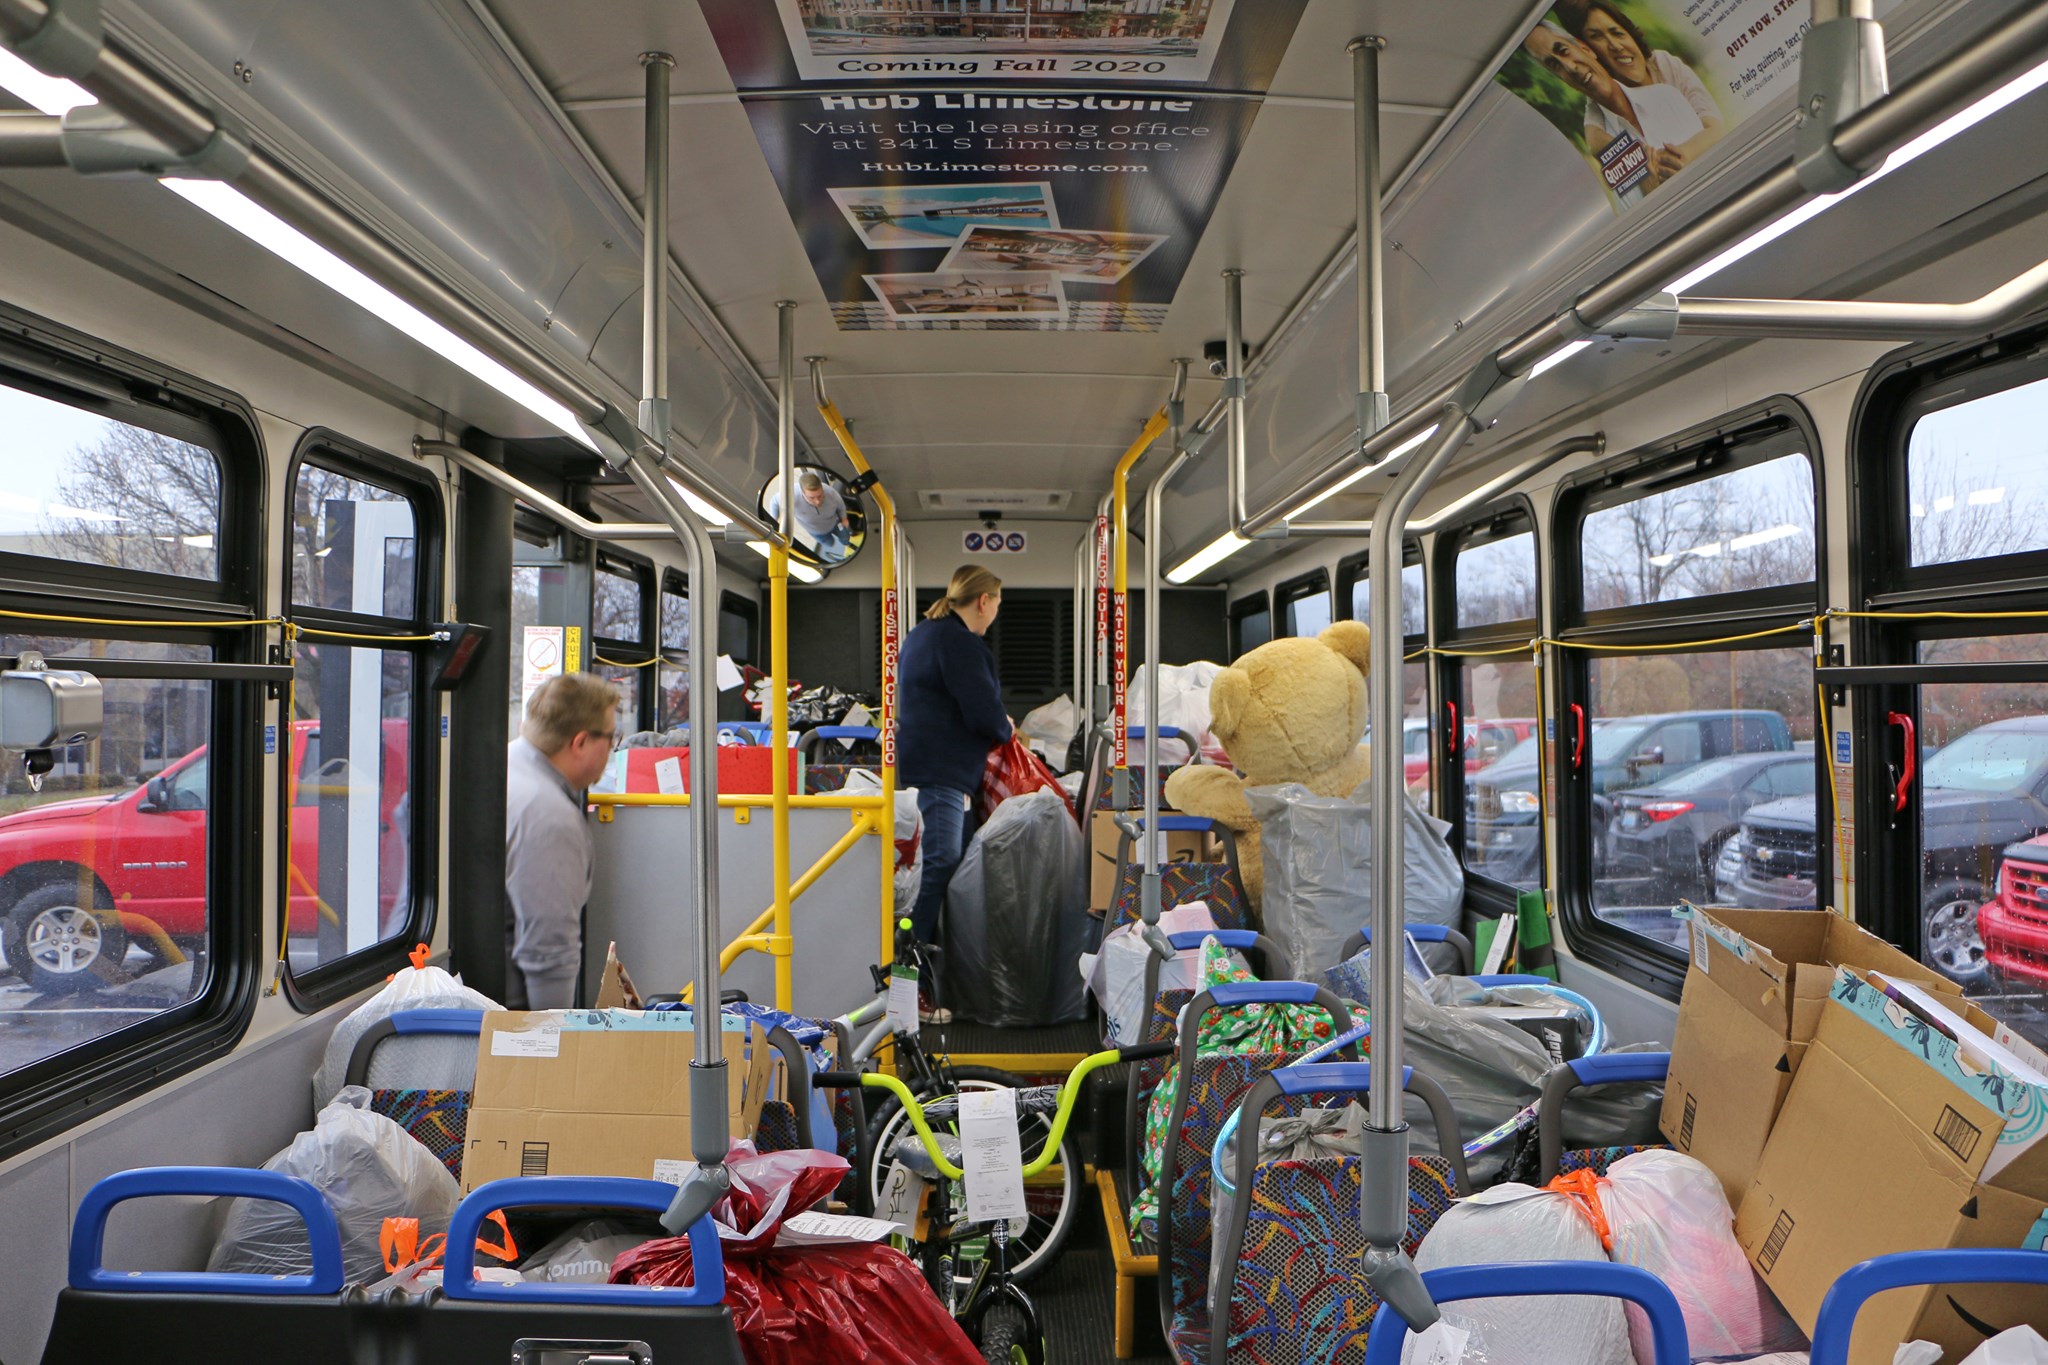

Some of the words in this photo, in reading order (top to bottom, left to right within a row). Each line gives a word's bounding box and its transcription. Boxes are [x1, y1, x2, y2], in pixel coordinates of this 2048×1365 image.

[1726, 33, 1749, 58] QUIT
[1748, 13, 1775, 38] NOW.
[1773, 0, 1798, 16] STA
[838, 59, 979, 74] Coming
[993, 59, 1057, 72] Fall
[1071, 60, 1166, 73] 2020
[1729, 79, 1742, 94] For
[1739, 68, 1757, 85] help
[1785, 32, 1801, 49] text
[820, 94, 920, 111] Hub
[934, 94, 1193, 112] Limestone
[800, 121, 884, 134] Visit
[895, 121, 954, 134] the
[968, 120, 1099, 138] leasing
[1110, 122, 1210, 136] office
[833, 139, 867, 150] at
[879, 138, 939, 150] 341
[953, 138, 971, 150] S
[985, 138, 1179, 151] Limestone.
[861, 162, 1149, 173] HubLimestone.com
[1600, 135, 1630, 164] KENTUCKY
[1098, 560, 1107, 588] CON
[886, 591, 896, 637] PISE
[1114, 594, 1125, 652] WATCH
[886, 642, 896, 678] CON
[1115, 659, 1125, 706] YOUR
[886, 682, 896, 765] CUIDADO
[1116, 716, 1125, 762] STEP
